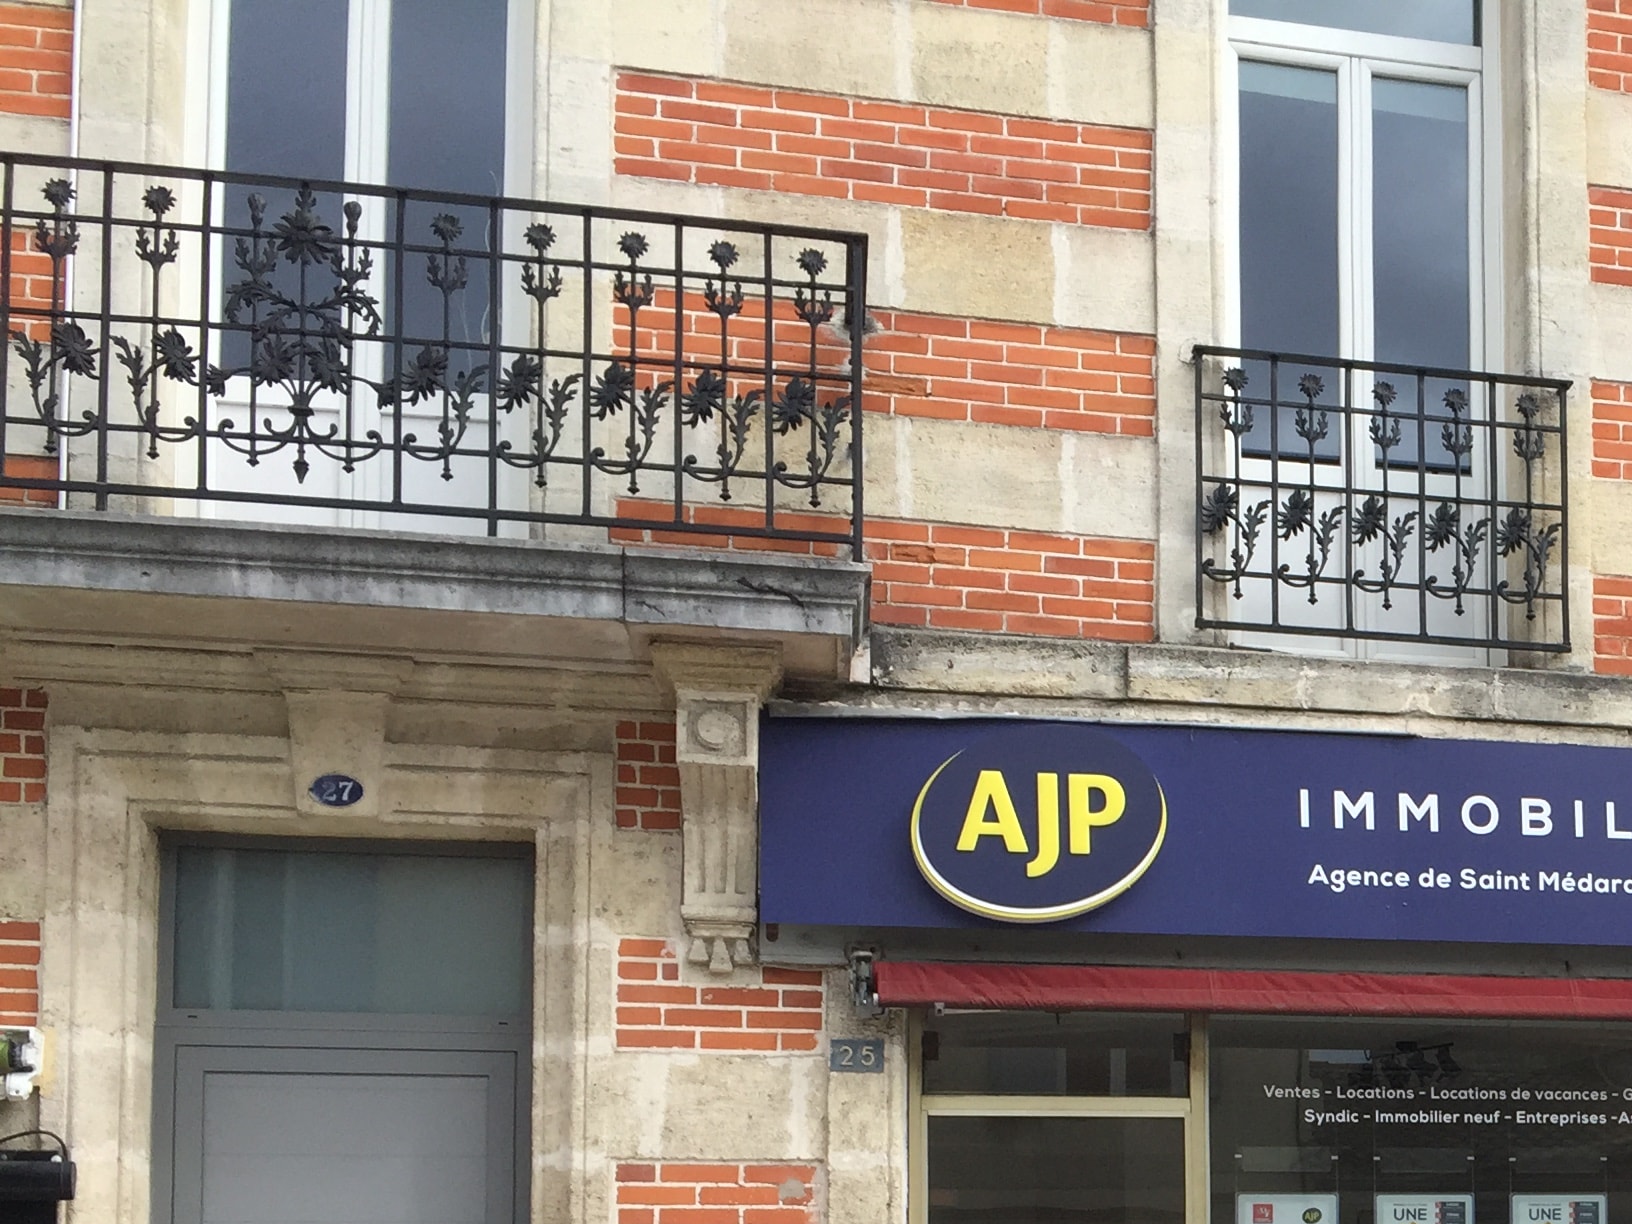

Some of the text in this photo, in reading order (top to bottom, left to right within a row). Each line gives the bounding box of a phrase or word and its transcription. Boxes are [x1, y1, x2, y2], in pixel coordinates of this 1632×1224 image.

[321, 781, 353, 801] 27
[956, 770, 1126, 878] AJP
[1308, 864, 1411, 894] Agence
[1419, 868, 1452, 889] de
[1460, 868, 1531, 892] Saint
[839, 1045, 875, 1066] 25
[1263, 1085, 1320, 1099] Ventes
[1337, 1086, 1415, 1099] Locations
[1430, 1087, 1507, 1100] Locations
[1511, 1087, 1531, 1101] de
[1535, 1090, 1608, 1101] vacances
[1304, 1109, 1359, 1126] Syndic
[1375, 1110, 1460, 1124] Immobilier
[1464, 1109, 1501, 1124] neuf
[1516, 1111, 1607, 1127] Entreprises
[1393, 1208, 1427, 1221] UNE
[1529, 1208, 1562, 1221] UNE
